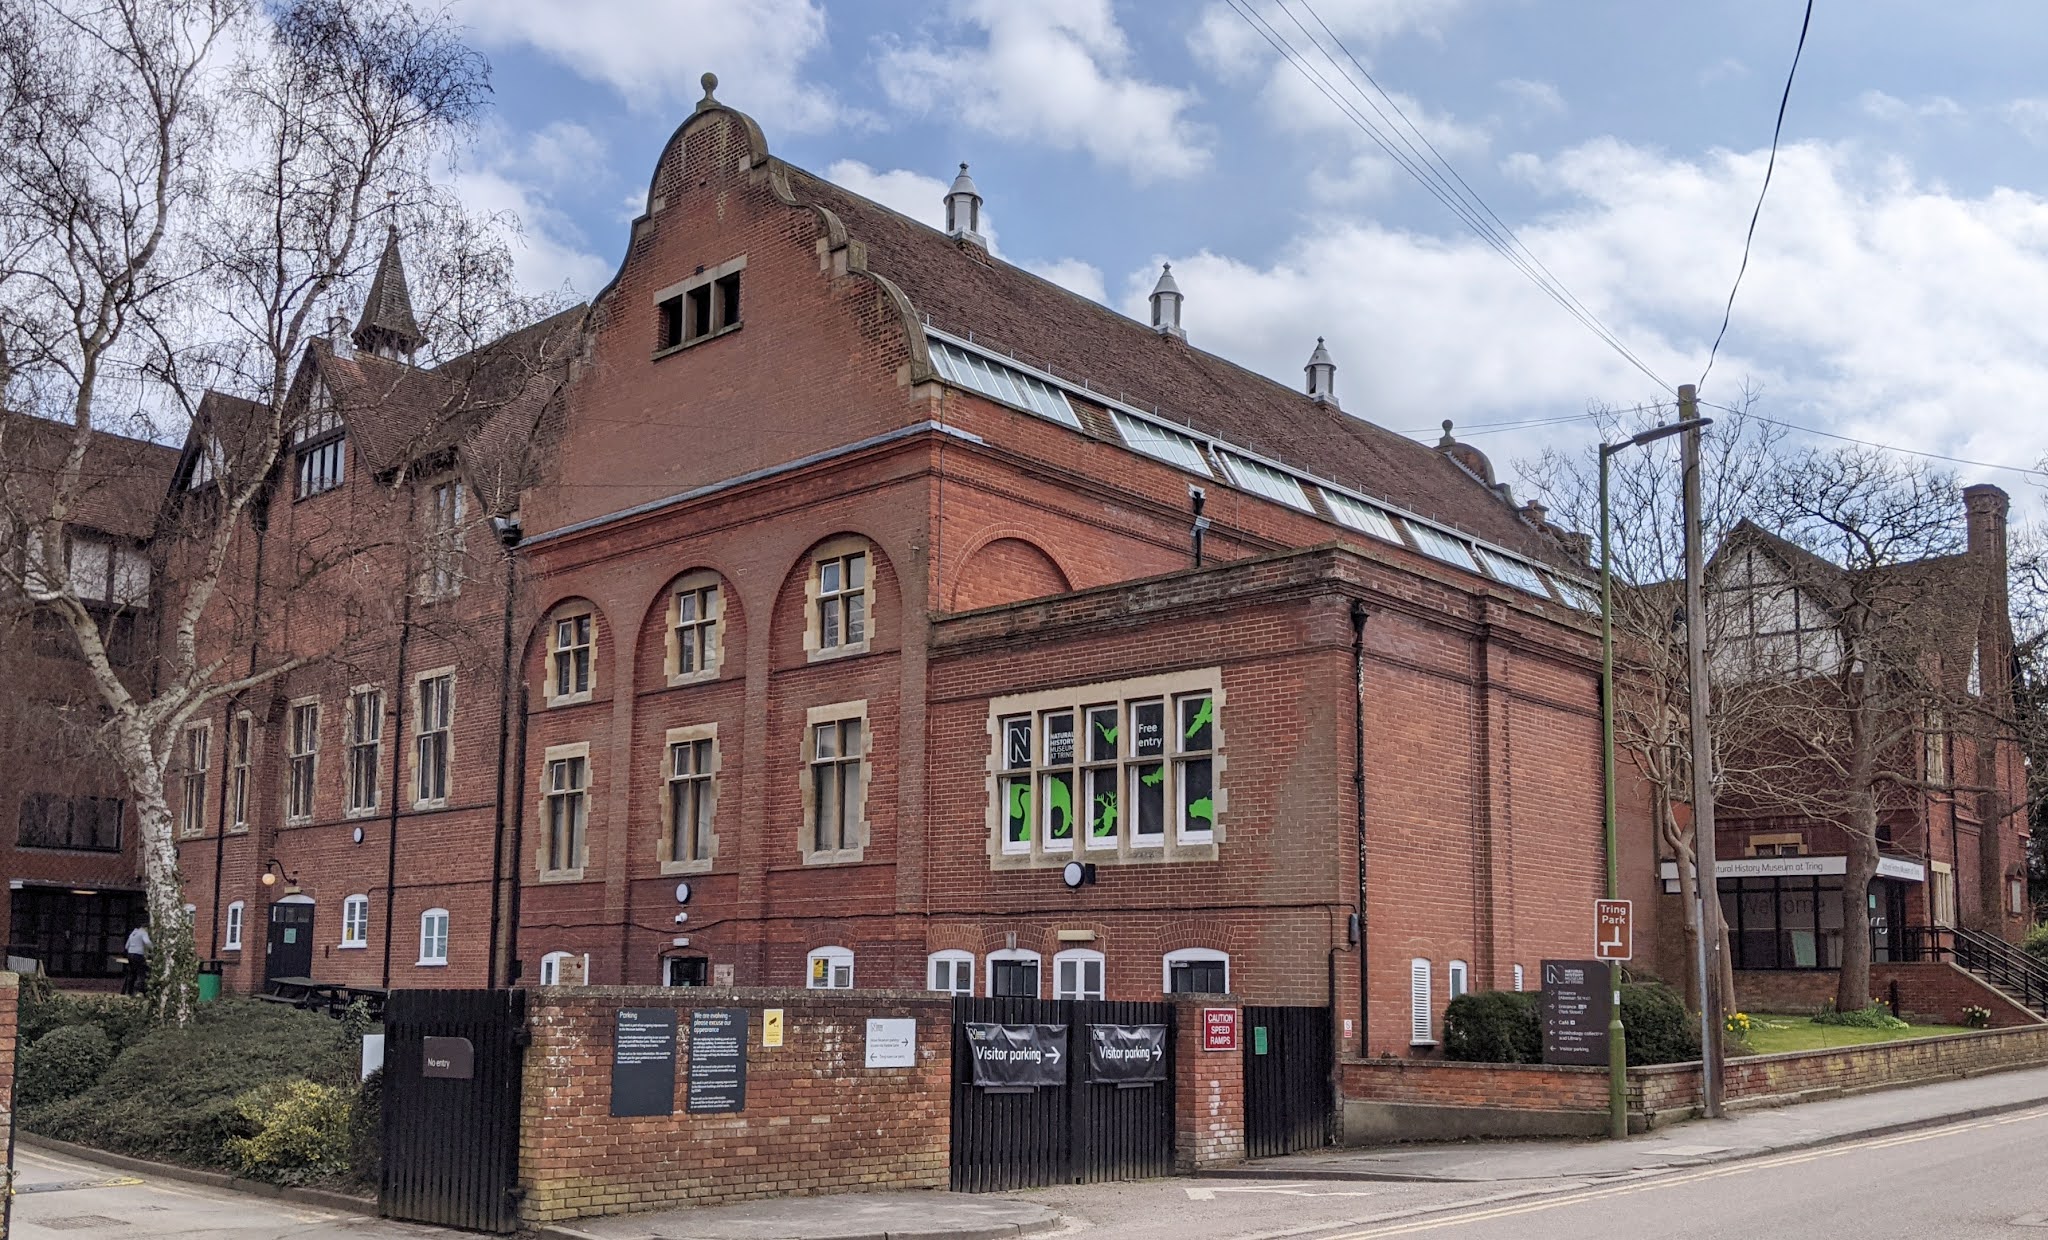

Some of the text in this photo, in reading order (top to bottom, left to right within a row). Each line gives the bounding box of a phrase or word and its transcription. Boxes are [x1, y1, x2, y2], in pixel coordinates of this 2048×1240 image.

[1139, 724, 1158, 733] Free
[1051, 731, 1074, 739] NATURAL
[1139, 737, 1162, 748] entry
[1716, 862, 1823, 874] tural History Museum at Tring
[1743, 891, 1826, 915] Welome
[1600, 904, 1626, 915] Tring
[1602, 915, 1625, 924] Park
[619, 1011, 637, 1020] Parking
[710, 1012, 728, 1020] evolving
[1208, 1013, 1233, 1022] CAUTION
[1211, 1026, 1230, 1034] SPEED
[1210, 1036, 1231, 1044] RAMPS
[976, 1046, 1042, 1064] Visitor parking
[1099, 1045, 1150, 1062] Visitor parking
[427, 1058, 450, 1069] No entry
